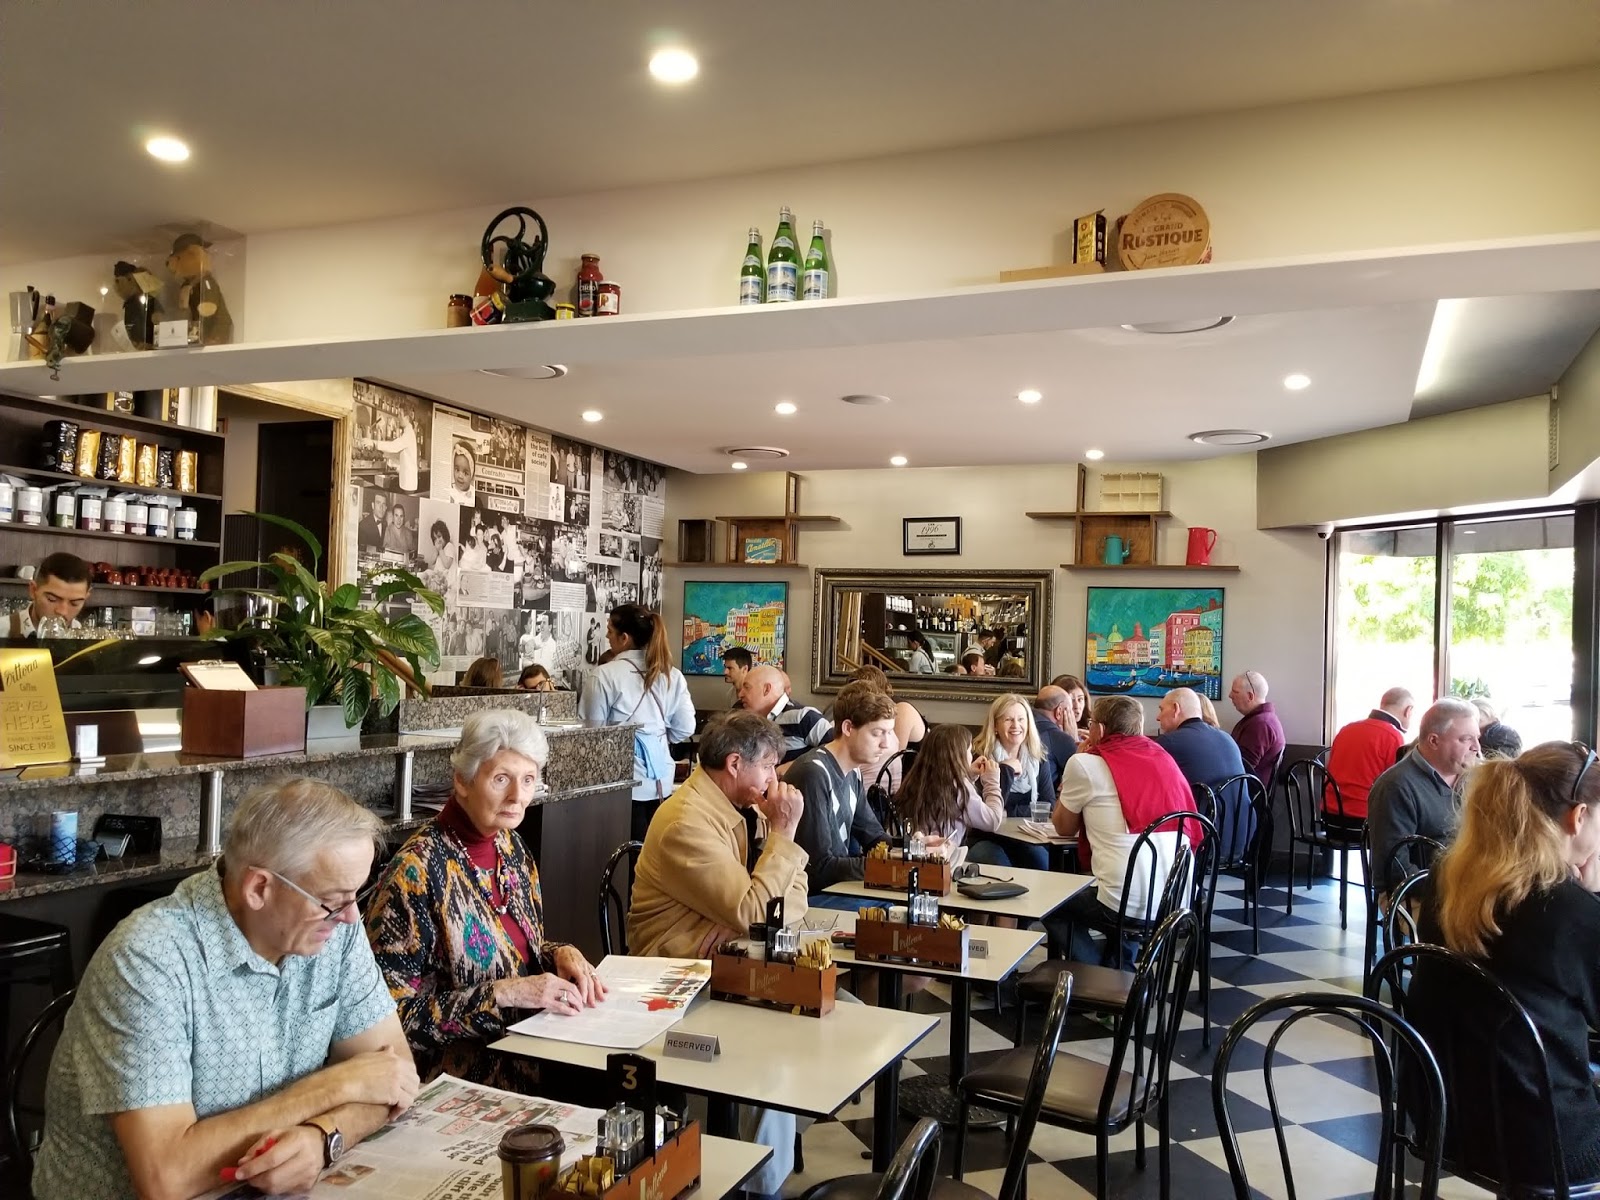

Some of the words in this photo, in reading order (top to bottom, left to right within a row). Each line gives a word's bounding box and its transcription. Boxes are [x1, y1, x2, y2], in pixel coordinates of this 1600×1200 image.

[1122, 229, 1203, 250] RUSTIQUE
[531, 459, 548, 468] society
[6, 714, 53, 731] HERE
[8, 743, 35, 753] SINCE
[773, 901, 781, 919] 4
[667, 1039, 712, 1052] RESERVED
[621, 1064, 638, 1090] 3
